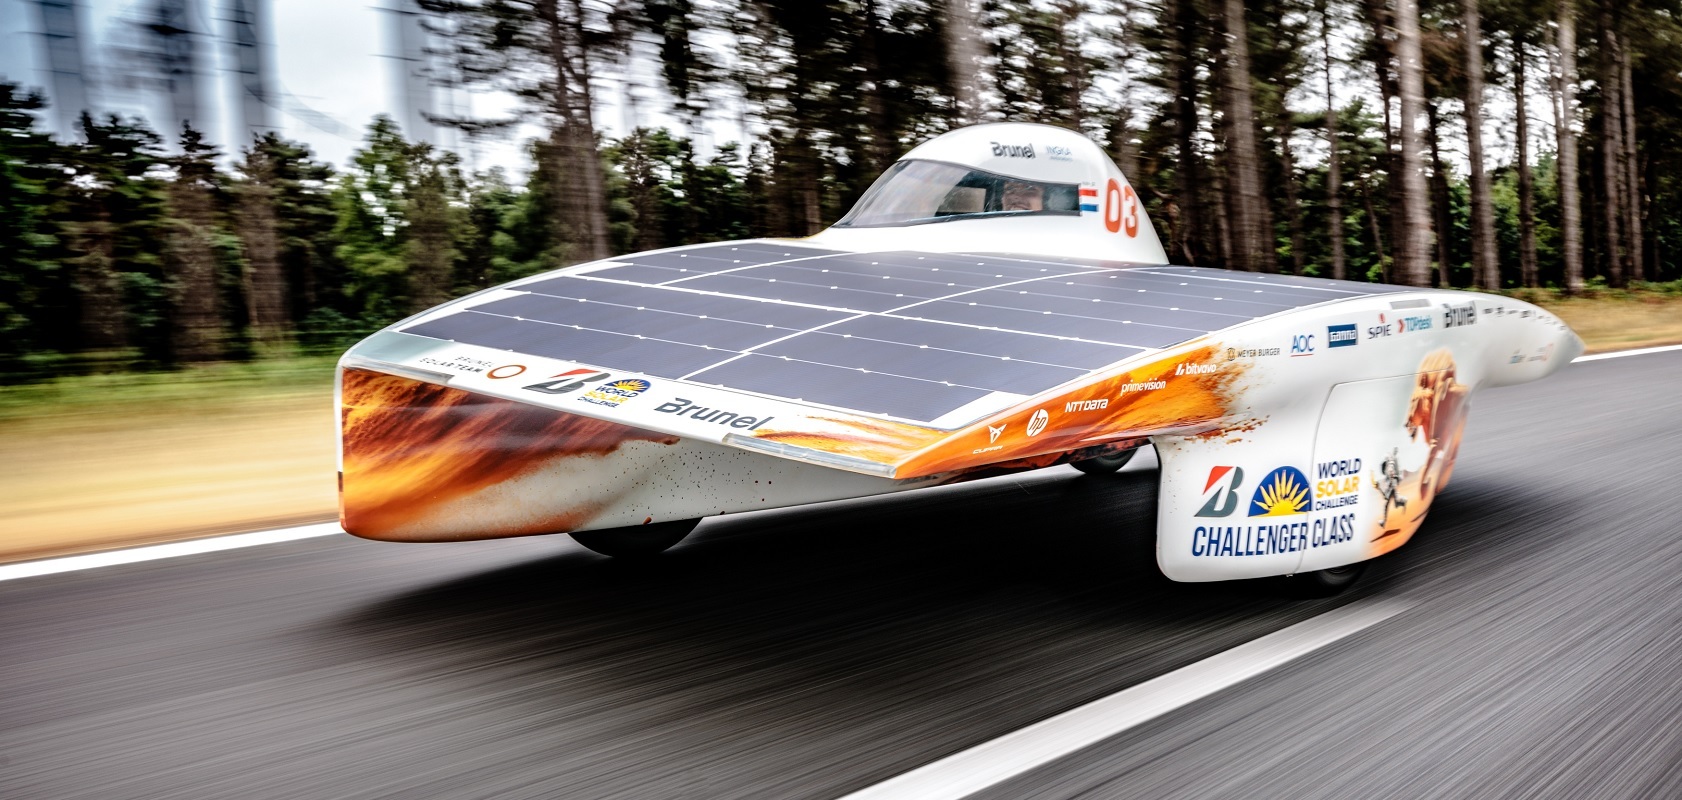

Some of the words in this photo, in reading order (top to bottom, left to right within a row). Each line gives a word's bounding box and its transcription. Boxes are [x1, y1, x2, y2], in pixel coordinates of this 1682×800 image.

[990, 141, 1036, 159] Brunel
[1105, 178, 1139, 238] 03
[1441, 300, 1478, 329] Brunel
[1237, 349, 1257, 358] MEYER
[1258, 347, 1281, 357] BURGER
[1291, 334, 1315, 354] AOC
[1185, 363, 1217, 375] bitvavo
[595, 385, 639, 398] WORLD
[1120, 378, 1166, 396] primevision
[577, 396, 620, 408] CHALLENGE
[584, 390, 629, 404] SOLAR
[654, 397, 774, 431] Brunel
[1318, 457, 1361, 480] WORLD
[1316, 477, 1360, 499] SOLAR
[1315, 494, 1359, 512] CHALLENGE
[1191, 521, 1307, 558] CHALLENGER
[1311, 512, 1356, 549] CLASS
